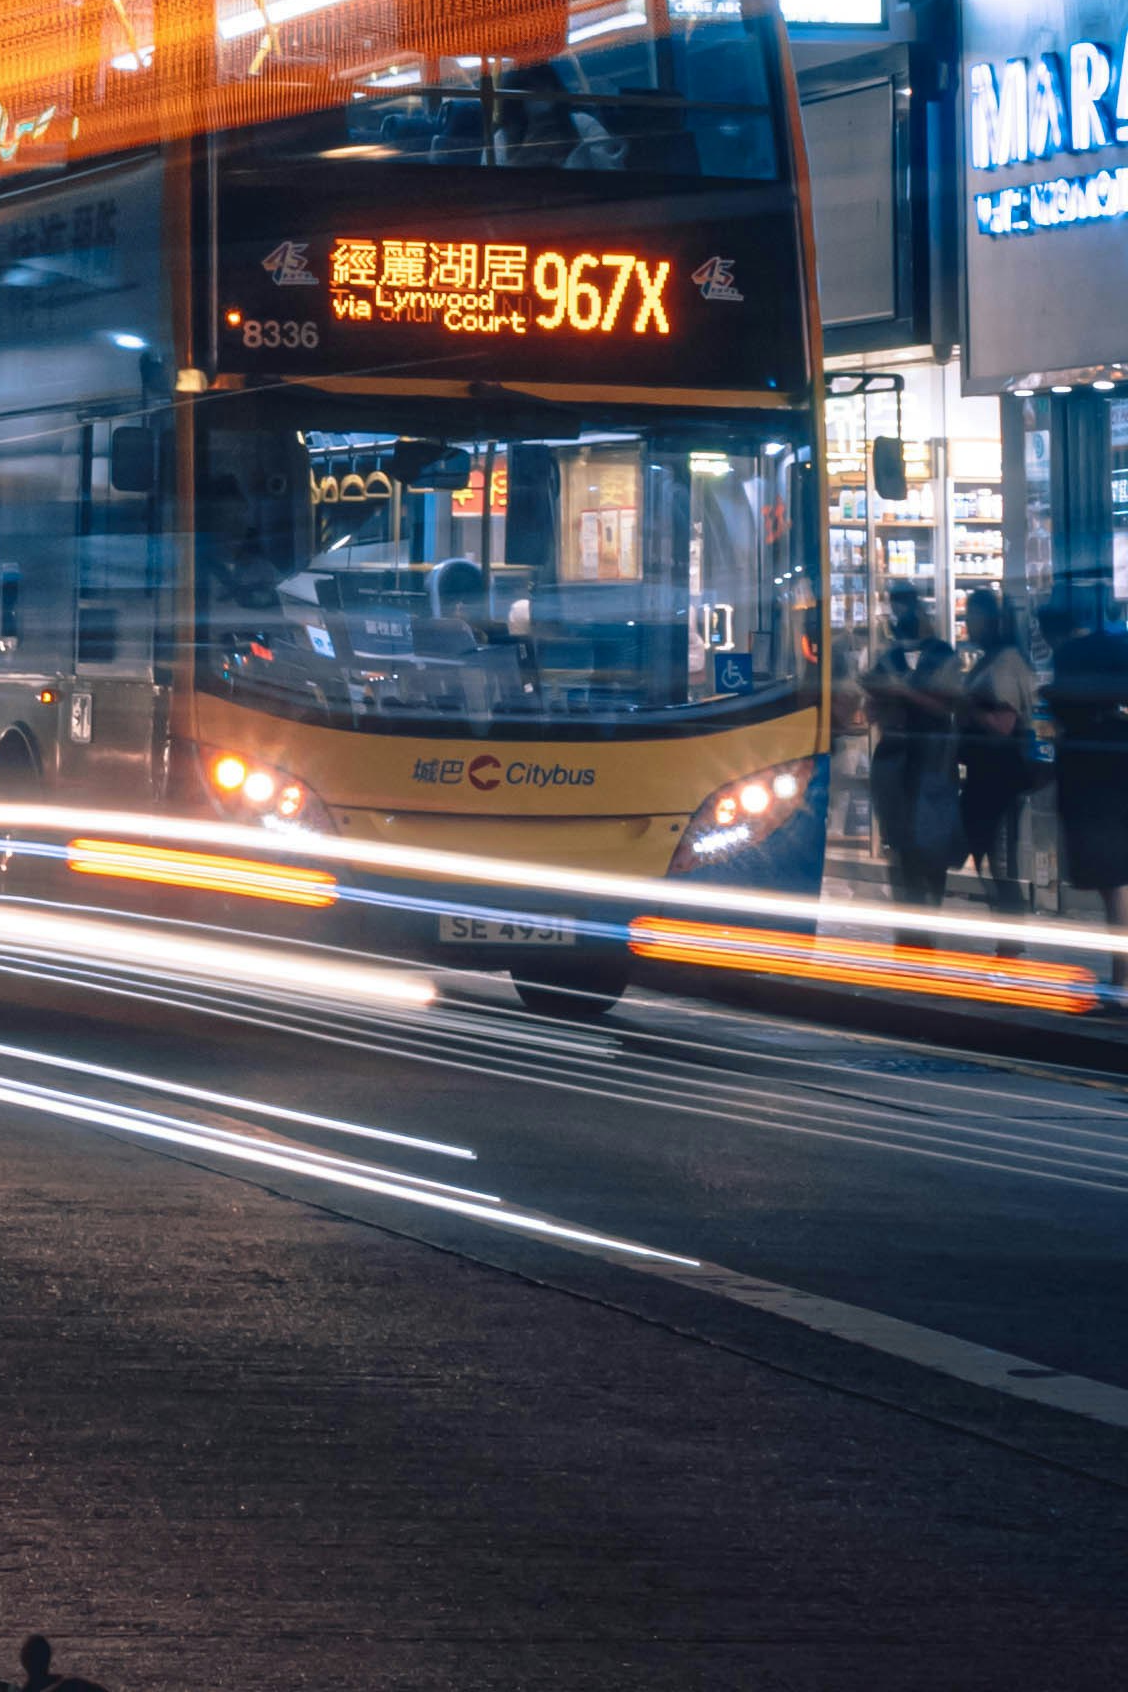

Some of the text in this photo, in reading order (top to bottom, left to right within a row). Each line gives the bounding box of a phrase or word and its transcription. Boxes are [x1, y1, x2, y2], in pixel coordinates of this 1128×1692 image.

[971, 30, 1128, 168] MAR
[332, 239, 527, 291] 經麗湖居
[332, 294, 371, 318] via
[375, 284, 495, 312] Lynwood
[533, 251, 670, 334] 967X
[243, 320, 319, 348] 8336
[443, 308, 527, 333] Court
[412, 758, 465, 785] 城巴
[505, 761, 596, 788] Citybus
[451, 915, 488, 940] SE
